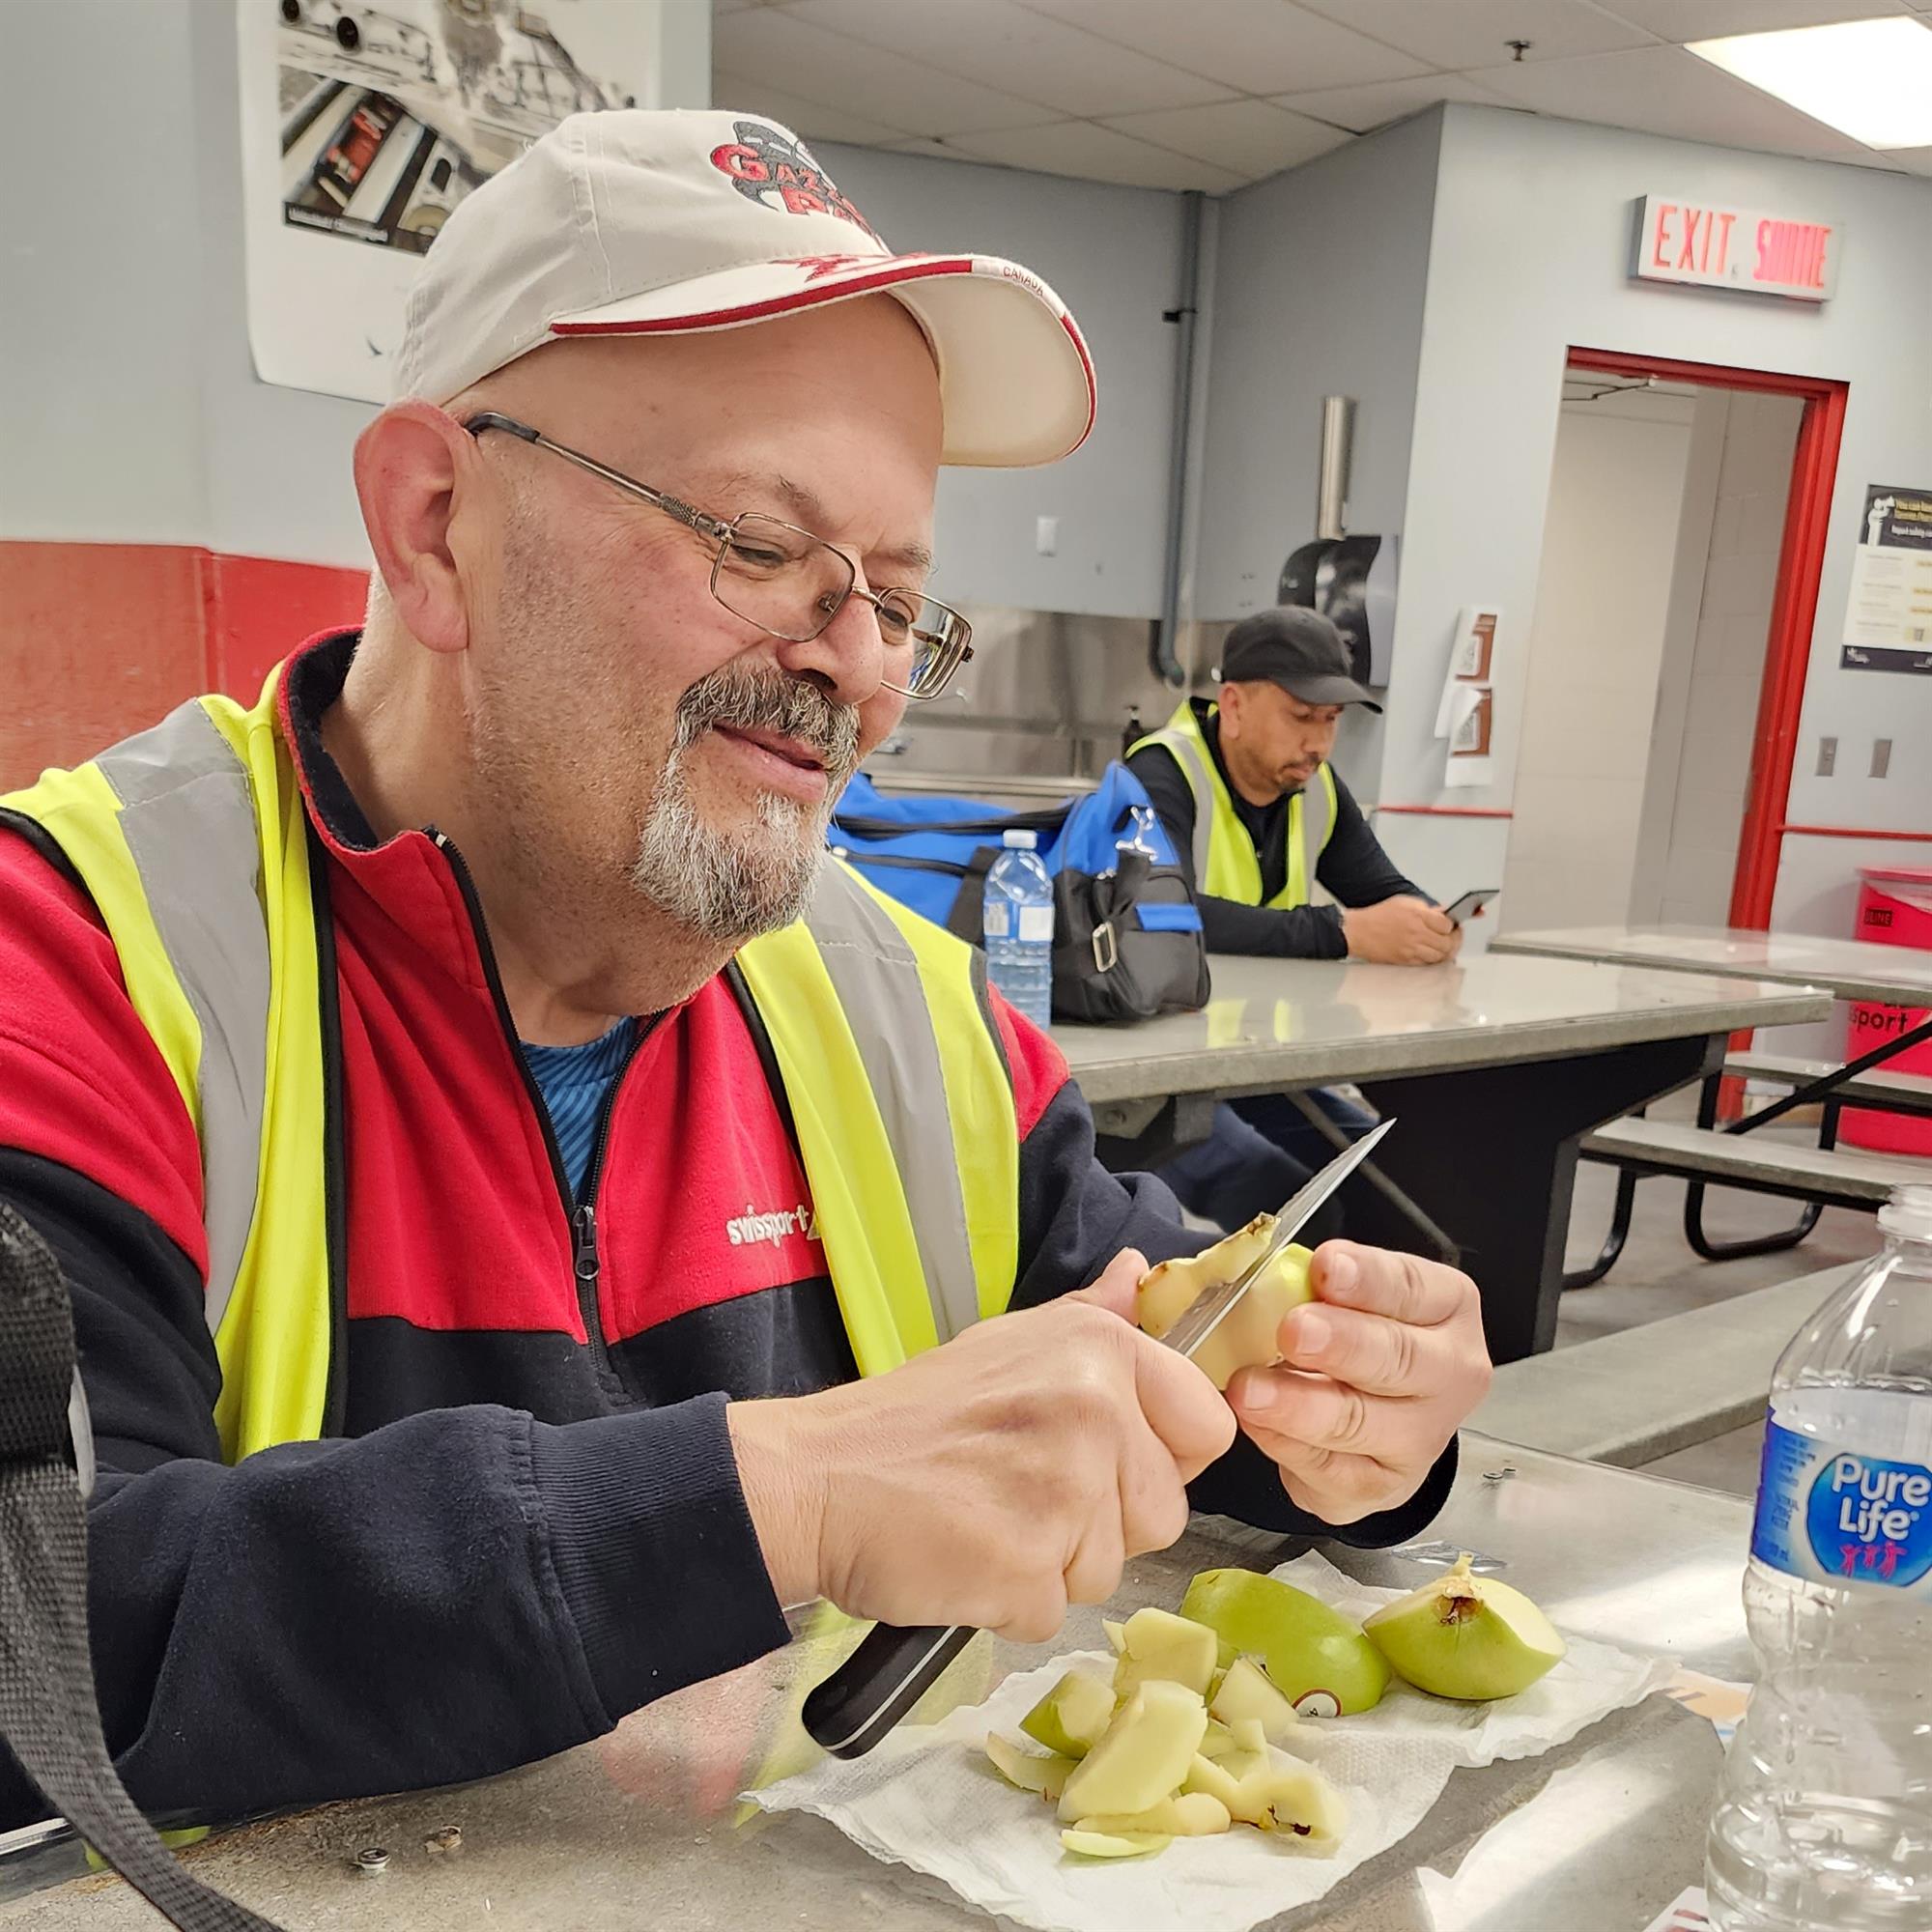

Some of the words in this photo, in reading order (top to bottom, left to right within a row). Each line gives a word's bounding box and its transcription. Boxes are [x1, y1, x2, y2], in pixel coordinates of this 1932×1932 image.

[1653, 204, 1736, 275] EXIT
[1003, 266, 1043, 297] CANADA
[726, 1205, 809, 1247] swissport
[1832, 1456, 1931, 1507] Pure
[1839, 1496, 1912, 1543] Life
